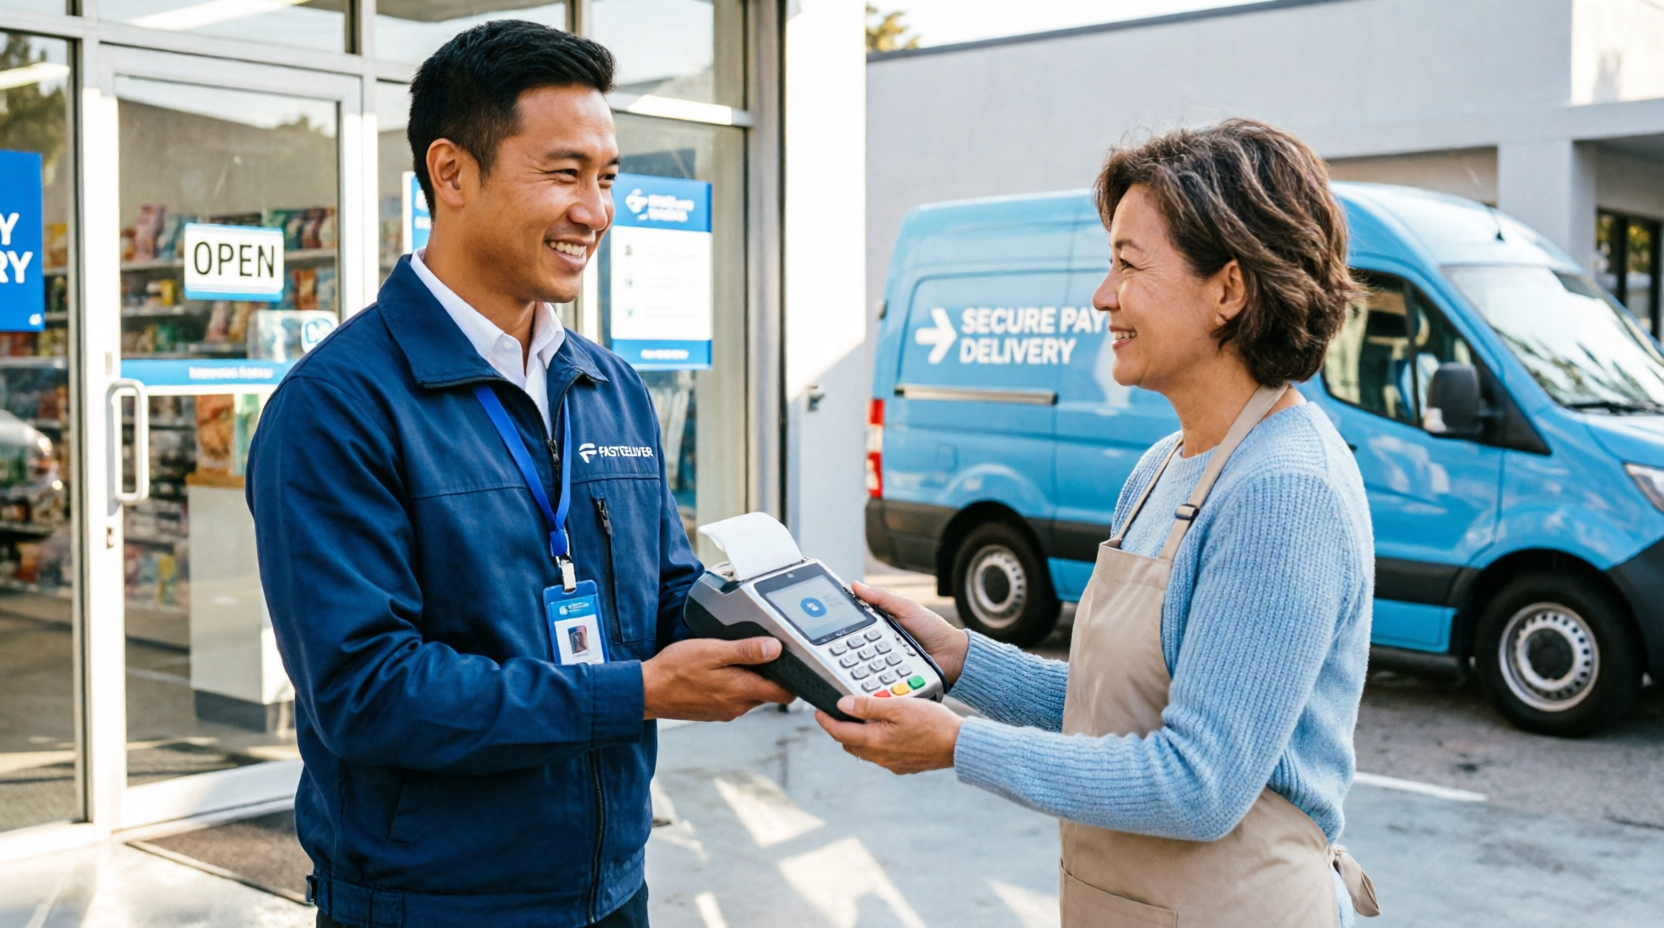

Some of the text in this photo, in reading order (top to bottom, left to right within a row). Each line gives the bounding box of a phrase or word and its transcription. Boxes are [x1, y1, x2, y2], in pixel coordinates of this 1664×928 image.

[193, 240, 275, 278] OPEN
[961, 306, 1107, 334] SECURE PAY
[959, 337, 1077, 365] DELIVERY
